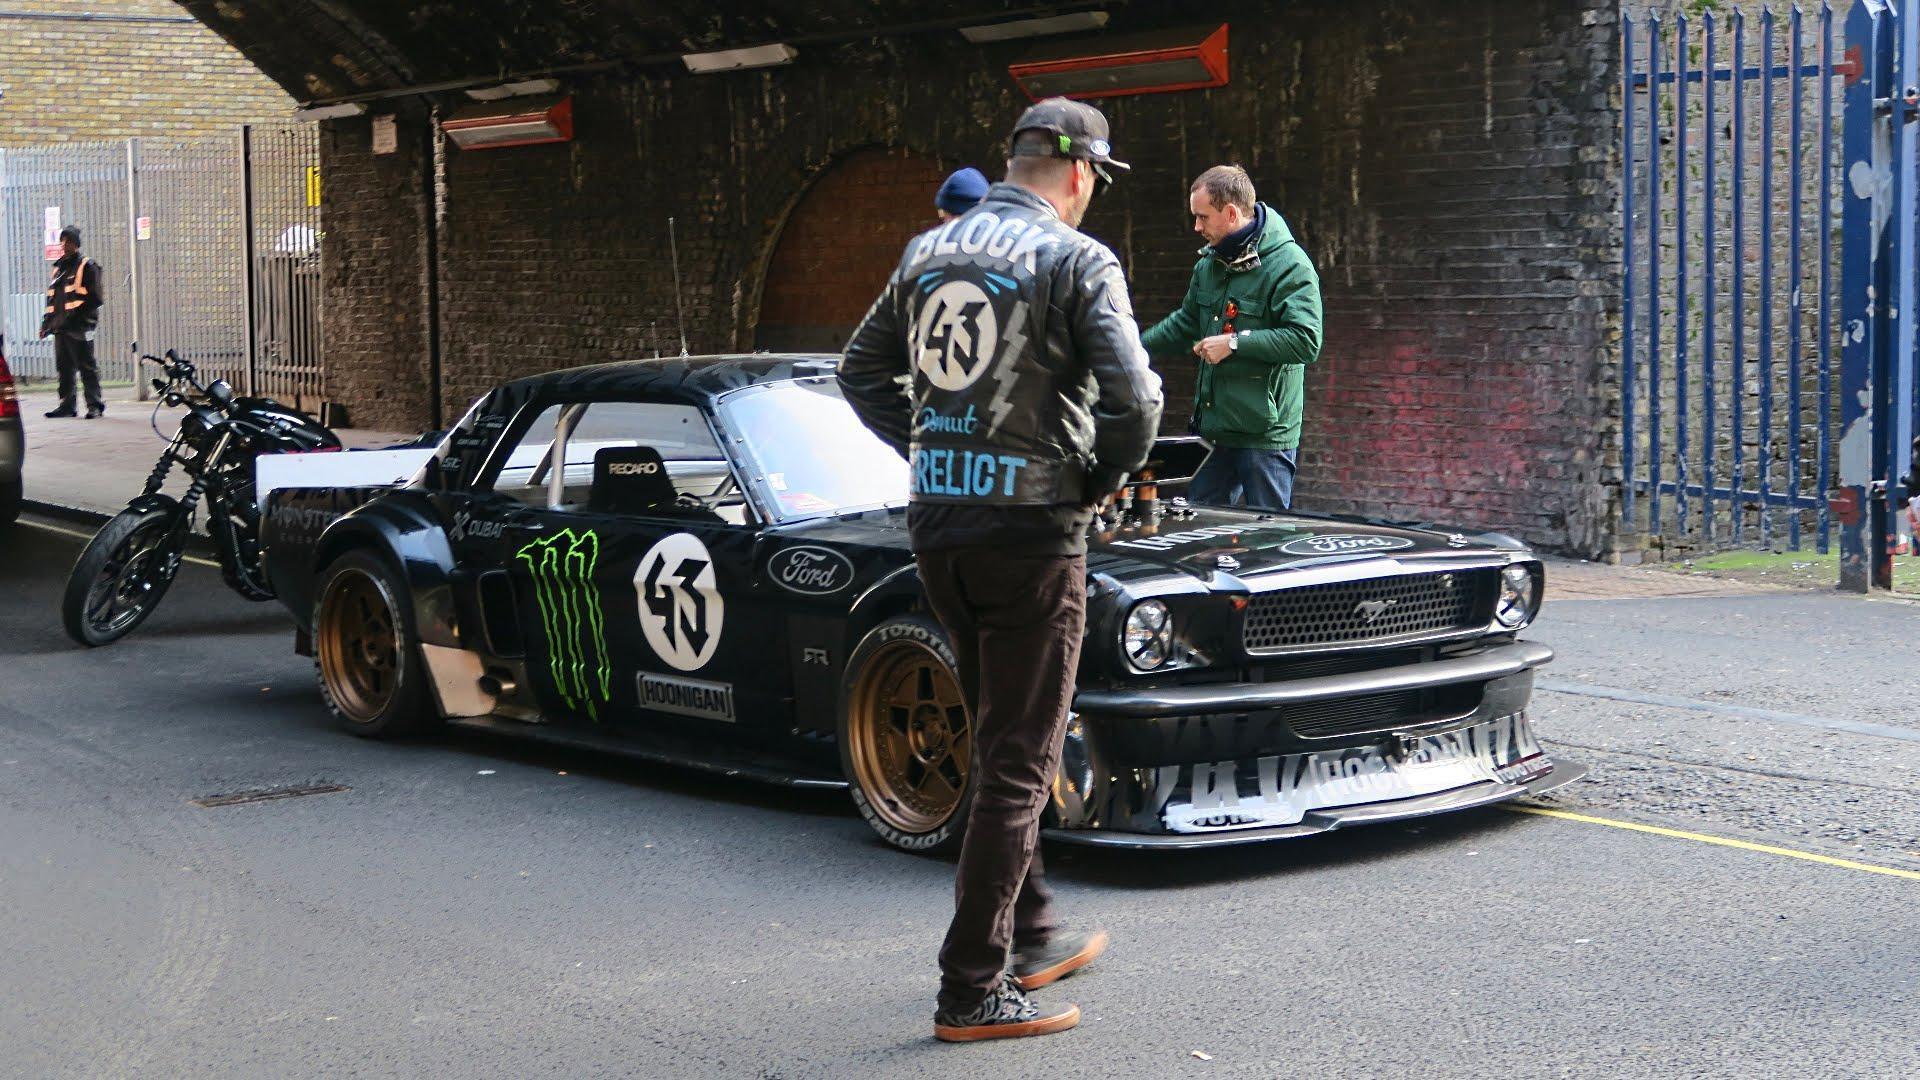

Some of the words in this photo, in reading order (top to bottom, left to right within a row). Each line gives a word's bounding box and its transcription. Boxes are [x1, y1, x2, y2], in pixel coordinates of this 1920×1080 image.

[908, 211, 1061, 276] BLOCK
[918, 403, 978, 435] Donut
[608, 462, 658, 475] RECARO
[911, 448, 1028, 497] RELICT
[1307, 534, 1392, 552] Ford
[782, 550, 839, 589] Ford
[879, 623, 929, 642] TOYO
[897, 825, 952, 850] TOYO
